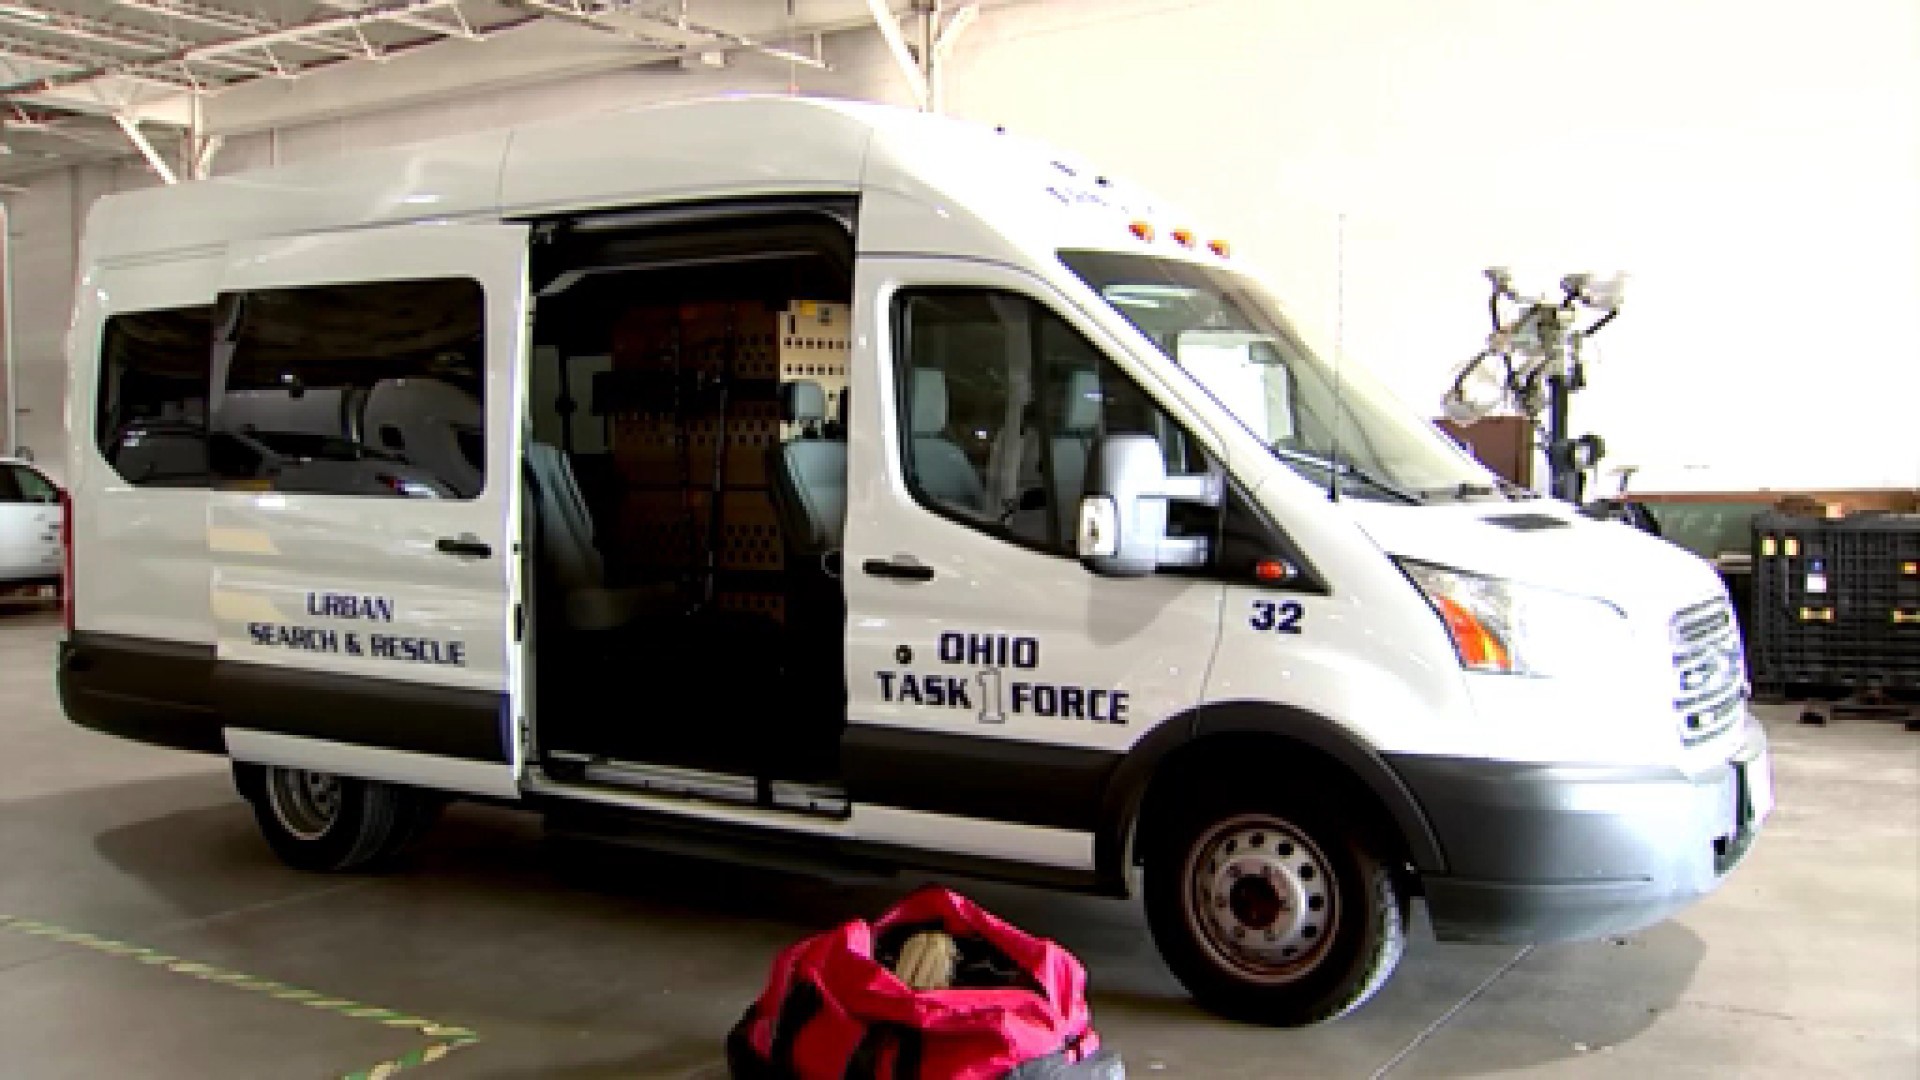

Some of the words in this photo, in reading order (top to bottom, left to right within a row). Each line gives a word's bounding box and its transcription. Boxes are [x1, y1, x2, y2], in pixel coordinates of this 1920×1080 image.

[306, 591, 394, 622] URBAN
[1249, 600, 1304, 634] 32
[247, 622, 338, 653] SEARCH
[344, 630, 364, 656] &
[370, 633, 466, 667] RESCUE
[938, 630, 1040, 669] OHIO
[874, 670, 972, 709] TASK
[976, 667, 1005, 724] 1
[1011, 682, 1130, 725] FORCE
